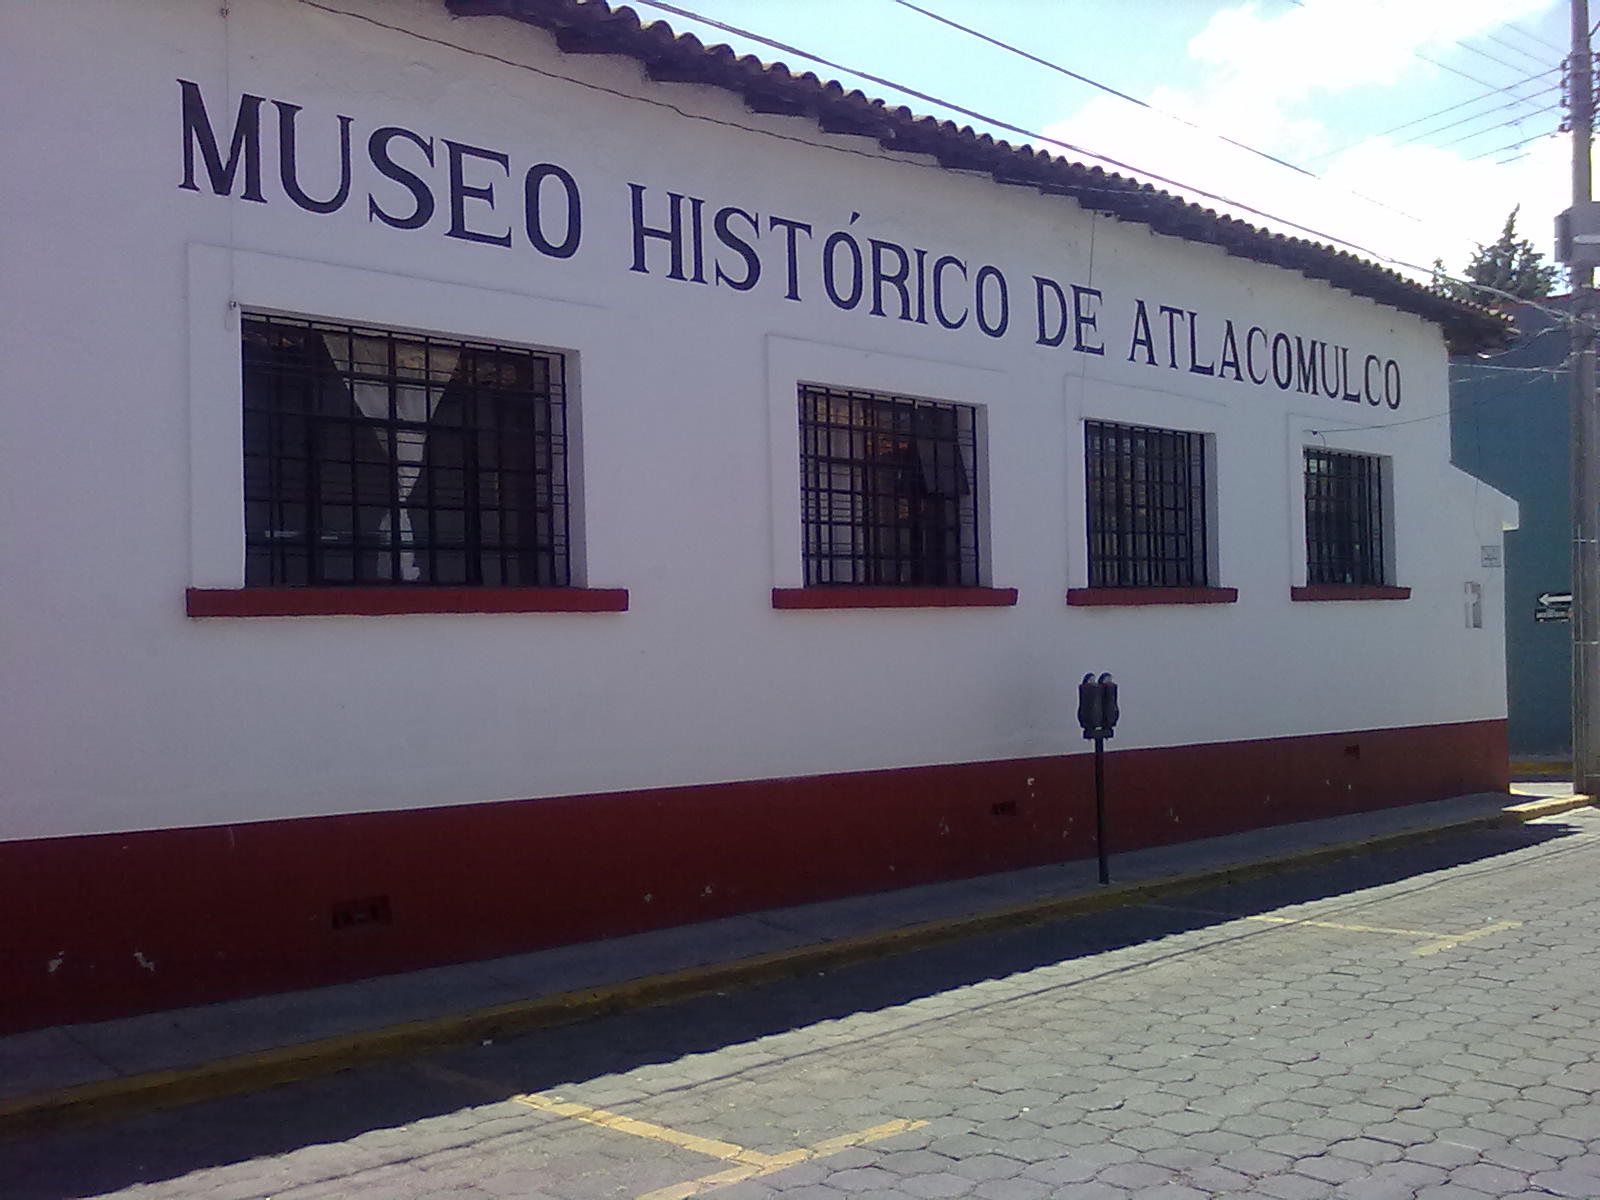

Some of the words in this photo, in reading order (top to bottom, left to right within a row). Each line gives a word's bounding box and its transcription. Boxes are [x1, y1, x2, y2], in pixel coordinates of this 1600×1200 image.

[176, 78, 582, 260] MUSEO
[626, 182, 1009, 339] HISTÓRICO
[1031, 275, 1105, 357] DE
[1126, 298, 1402, 411] ATLACOMULCO
